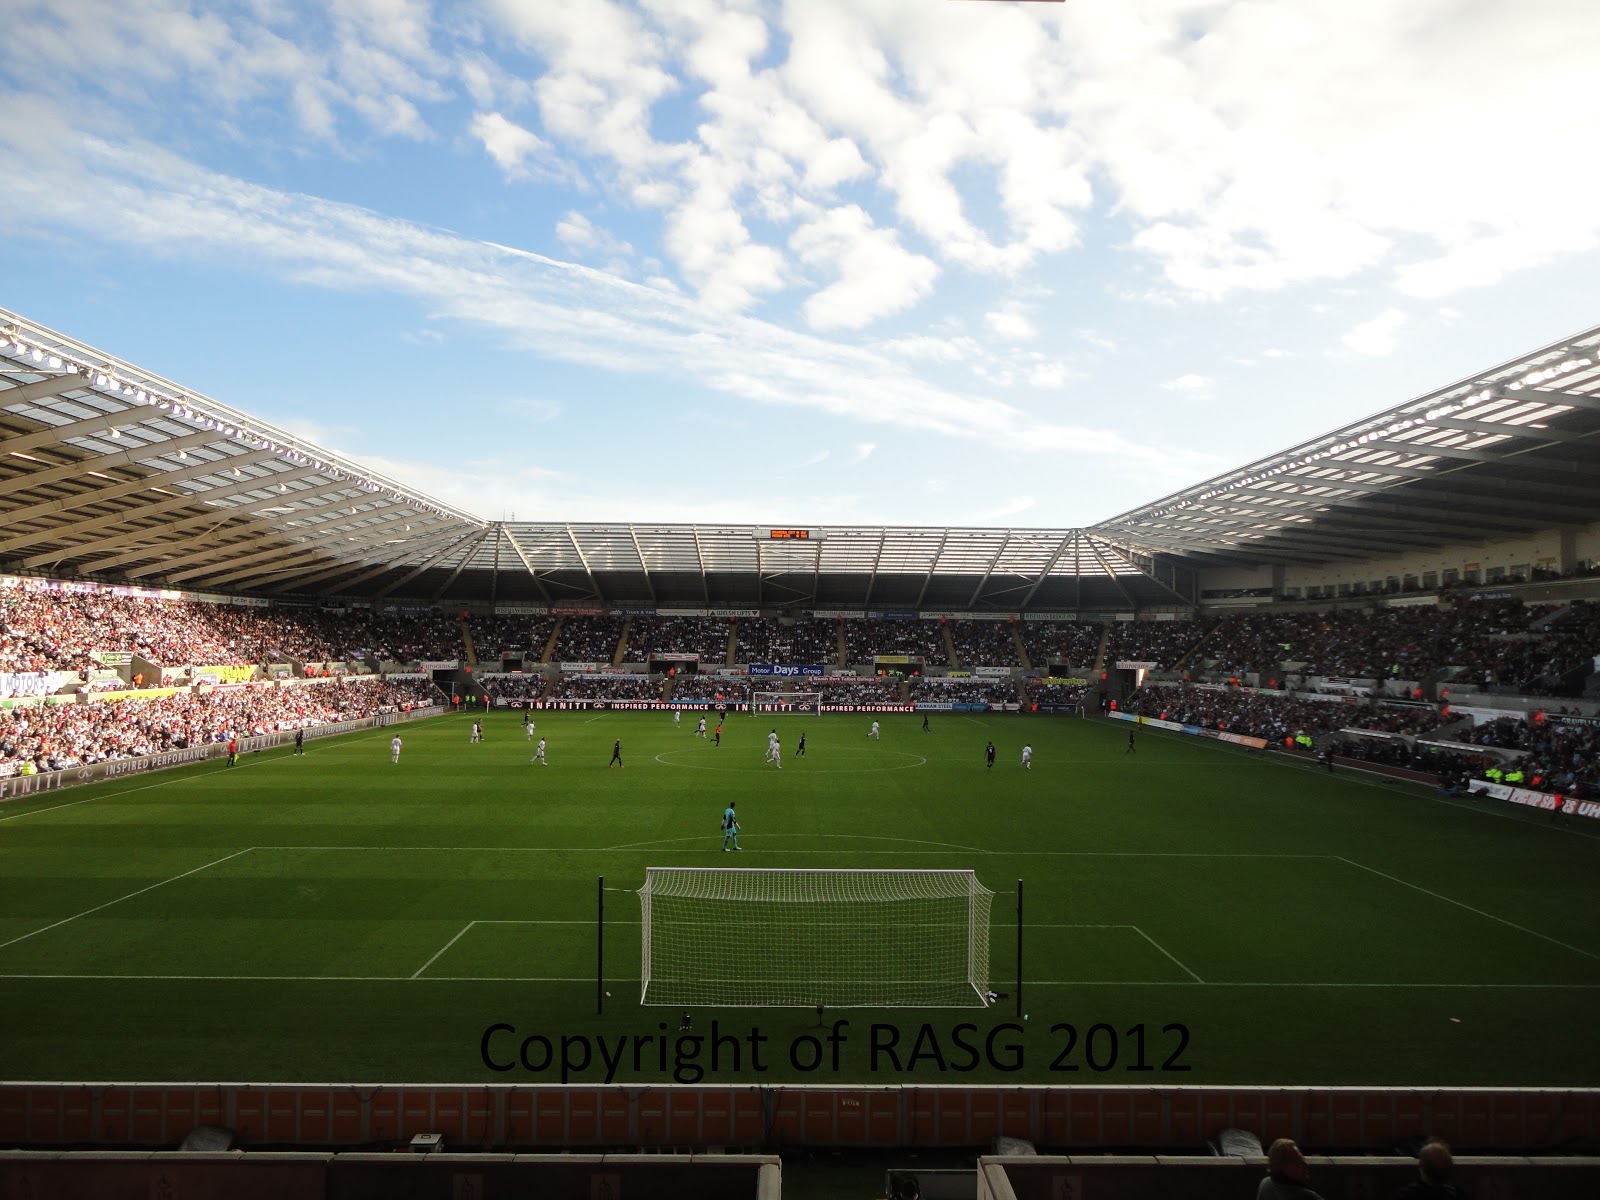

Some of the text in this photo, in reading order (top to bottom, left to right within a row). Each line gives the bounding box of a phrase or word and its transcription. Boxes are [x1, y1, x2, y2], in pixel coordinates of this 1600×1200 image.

[802, 667, 821, 675] Group
[530, 702, 587, 710] INFINITI
[106, 759, 148, 775] INSPIRED
[152, 748, 209, 767] PERFORMANCE
[238, 735, 280, 751] INFINITI
[302, 727, 323, 738] NSPIRED
[325, 721, 356, 733] PERFORMANCE
[373, 714, 397, 727] INFINITI
